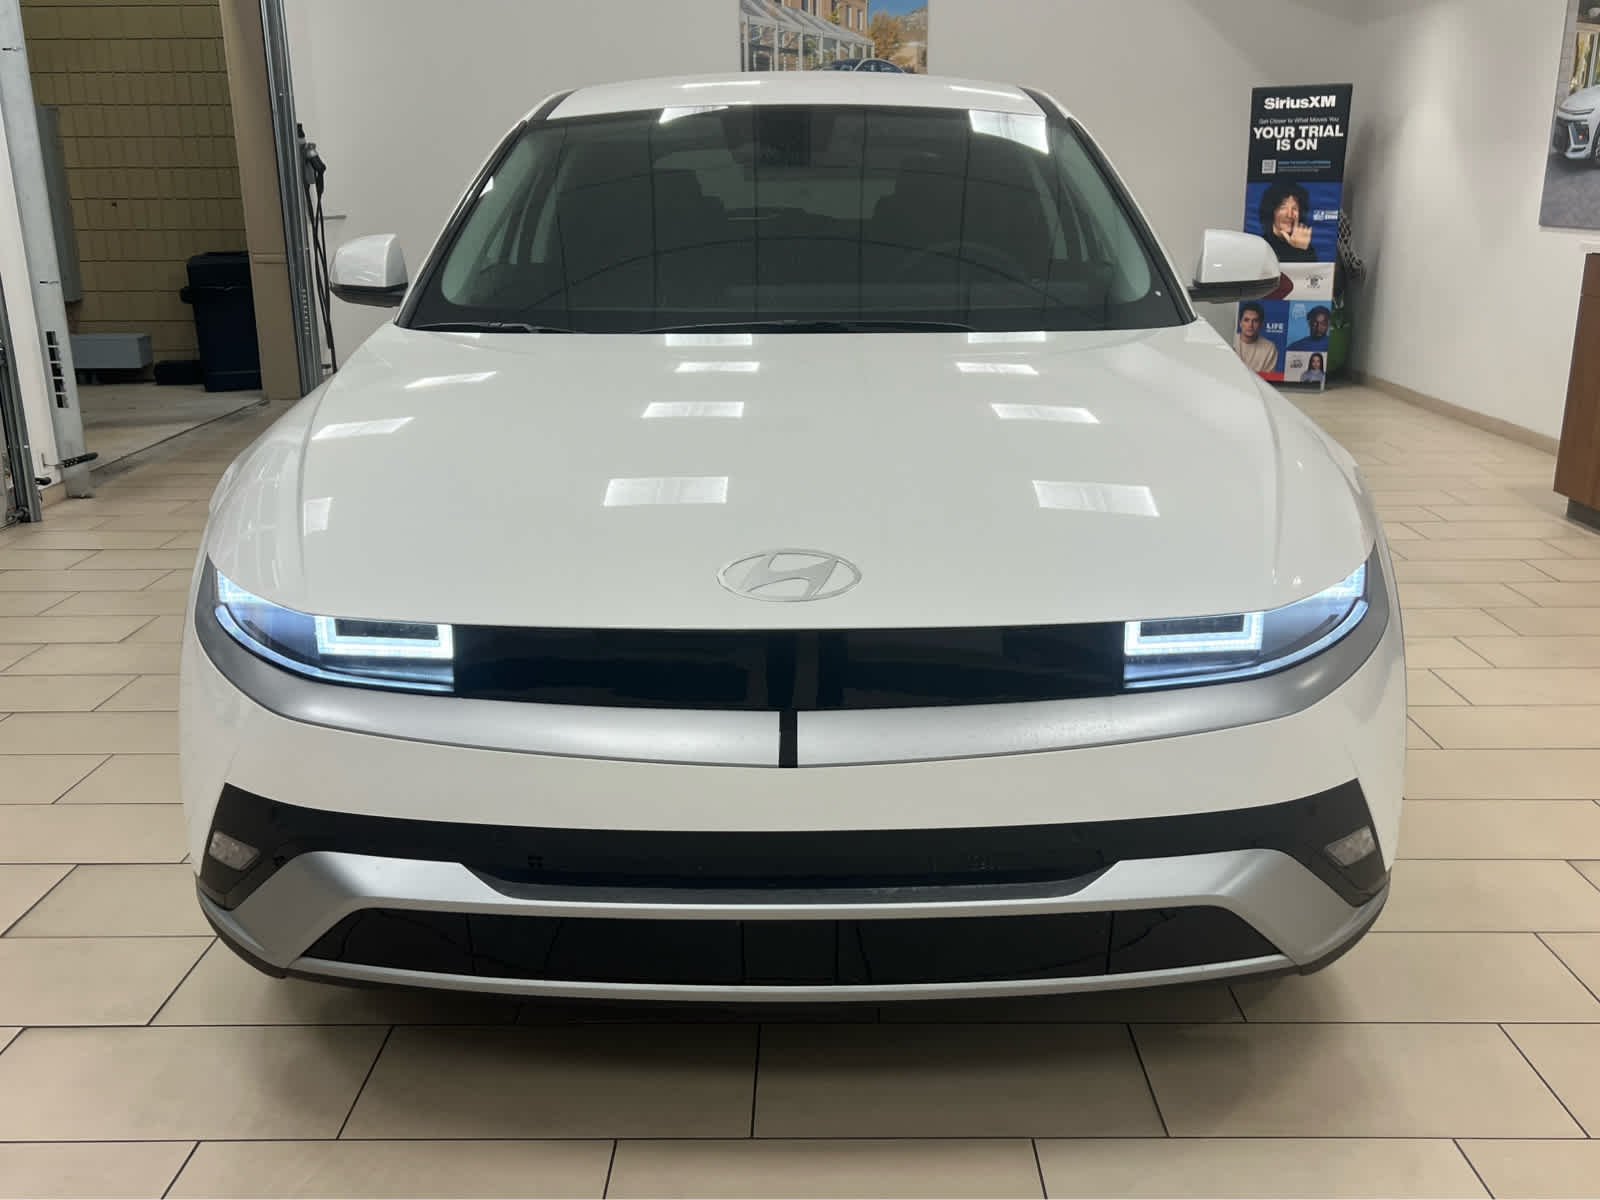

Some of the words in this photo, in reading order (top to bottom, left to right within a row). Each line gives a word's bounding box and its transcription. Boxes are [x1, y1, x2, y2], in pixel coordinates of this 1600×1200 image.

[1264, 95, 1336, 109] SiriusXM
[1253, 126, 1295, 139] YOUR
[1299, 124, 1344, 138] TRIAL
[1276, 139, 1291, 151] IS
[1294, 138, 1318, 151] ON
[1266, 322, 1284, 330] LIFE
